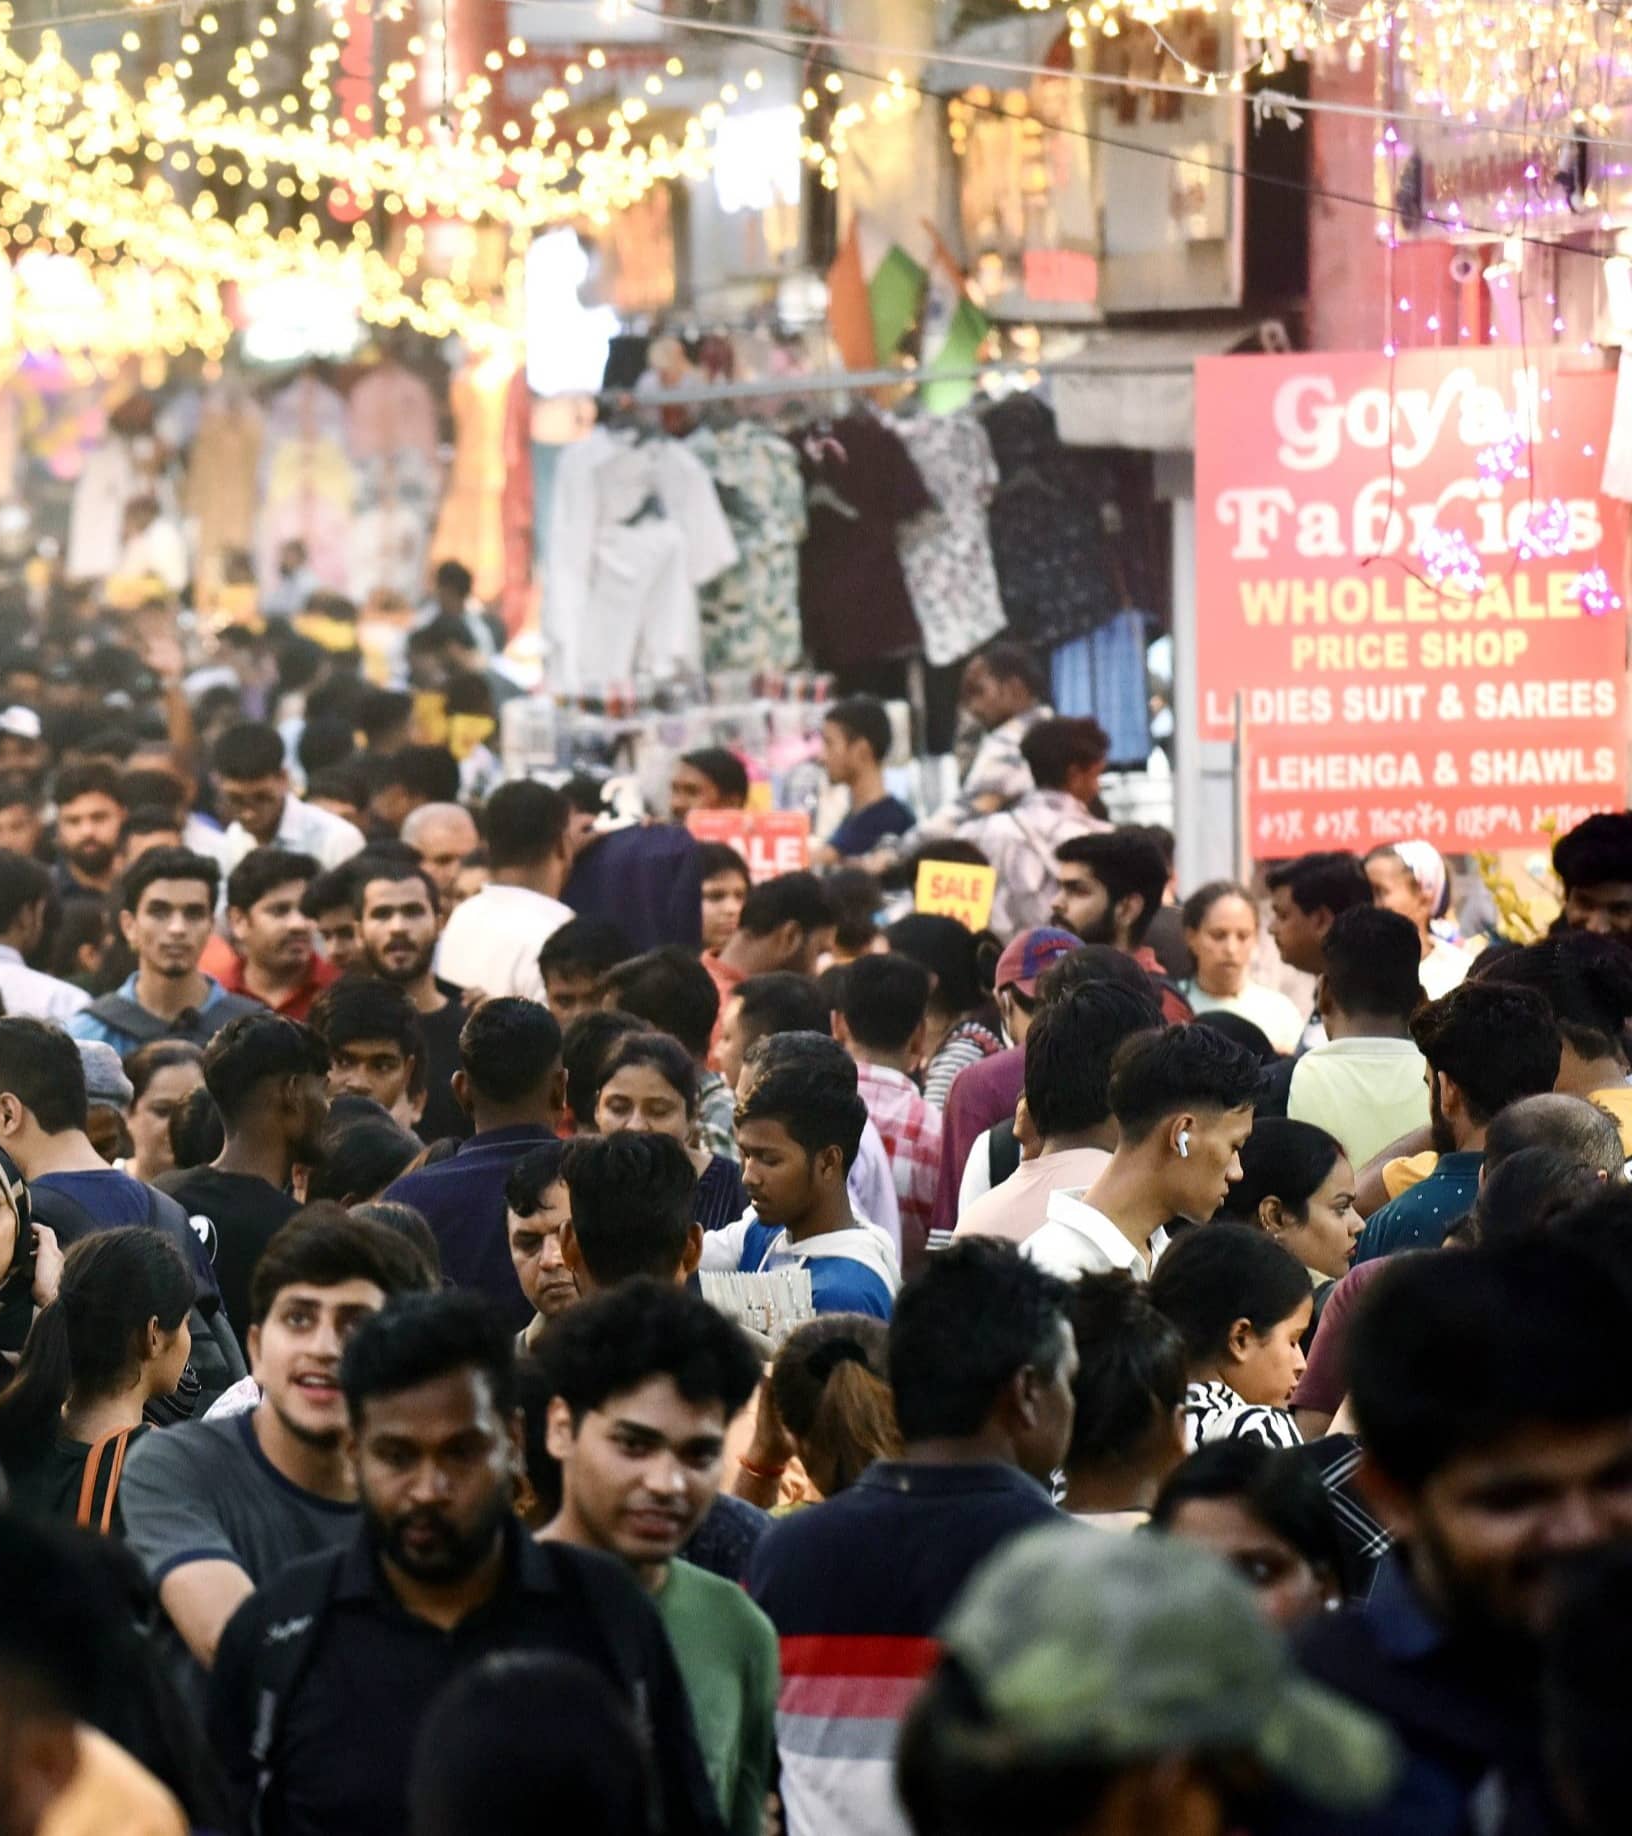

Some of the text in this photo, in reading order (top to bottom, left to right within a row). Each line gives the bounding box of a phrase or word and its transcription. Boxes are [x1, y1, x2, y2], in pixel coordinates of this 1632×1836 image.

[1274, 366, 1541, 470] Goyal
[1240, 571, 1581, 625] WHOLESALE
[1291, 629, 1528, 670] PRICE SHOP
[1343, 684, 1427, 722] SUIT
[1437, 683, 1464, 720] &
[1474, 679, 1616, 719] SAREES
[1258, 747, 1615, 790] LEHENGA & SHAWLS
[729, 836, 802, 870] LE
[931, 873, 983, 903] SALE
